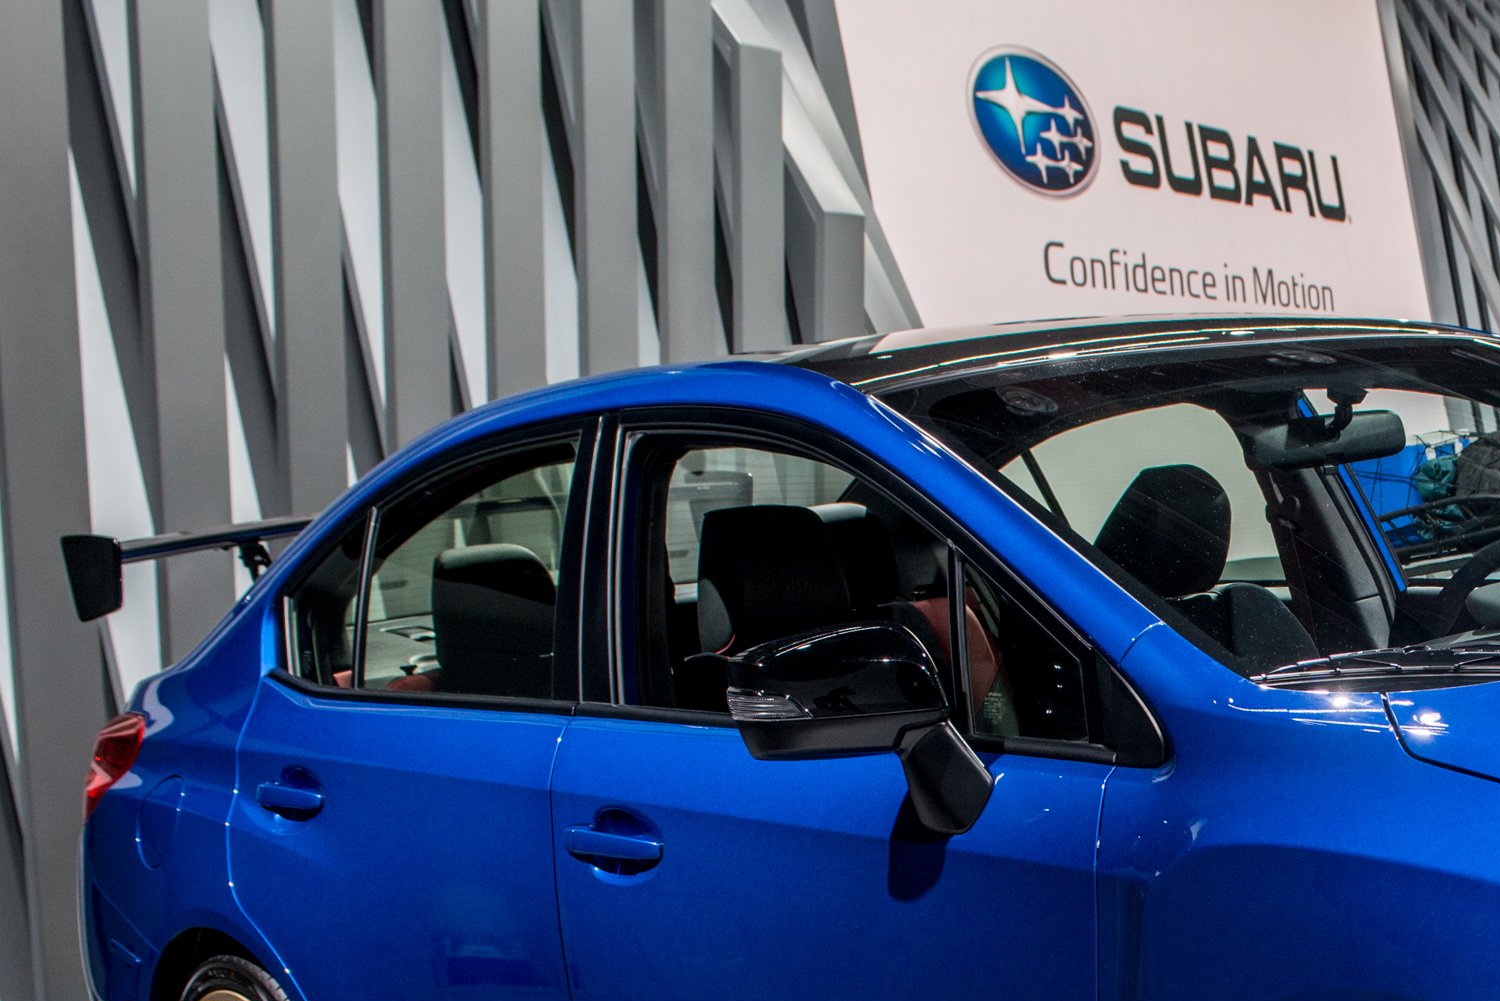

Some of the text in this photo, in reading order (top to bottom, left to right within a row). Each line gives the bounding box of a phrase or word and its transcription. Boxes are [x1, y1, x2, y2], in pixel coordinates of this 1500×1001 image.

[1113, 105, 1347, 223] SUBARU
[1043, 240, 1335, 312] Confidence in Motion
